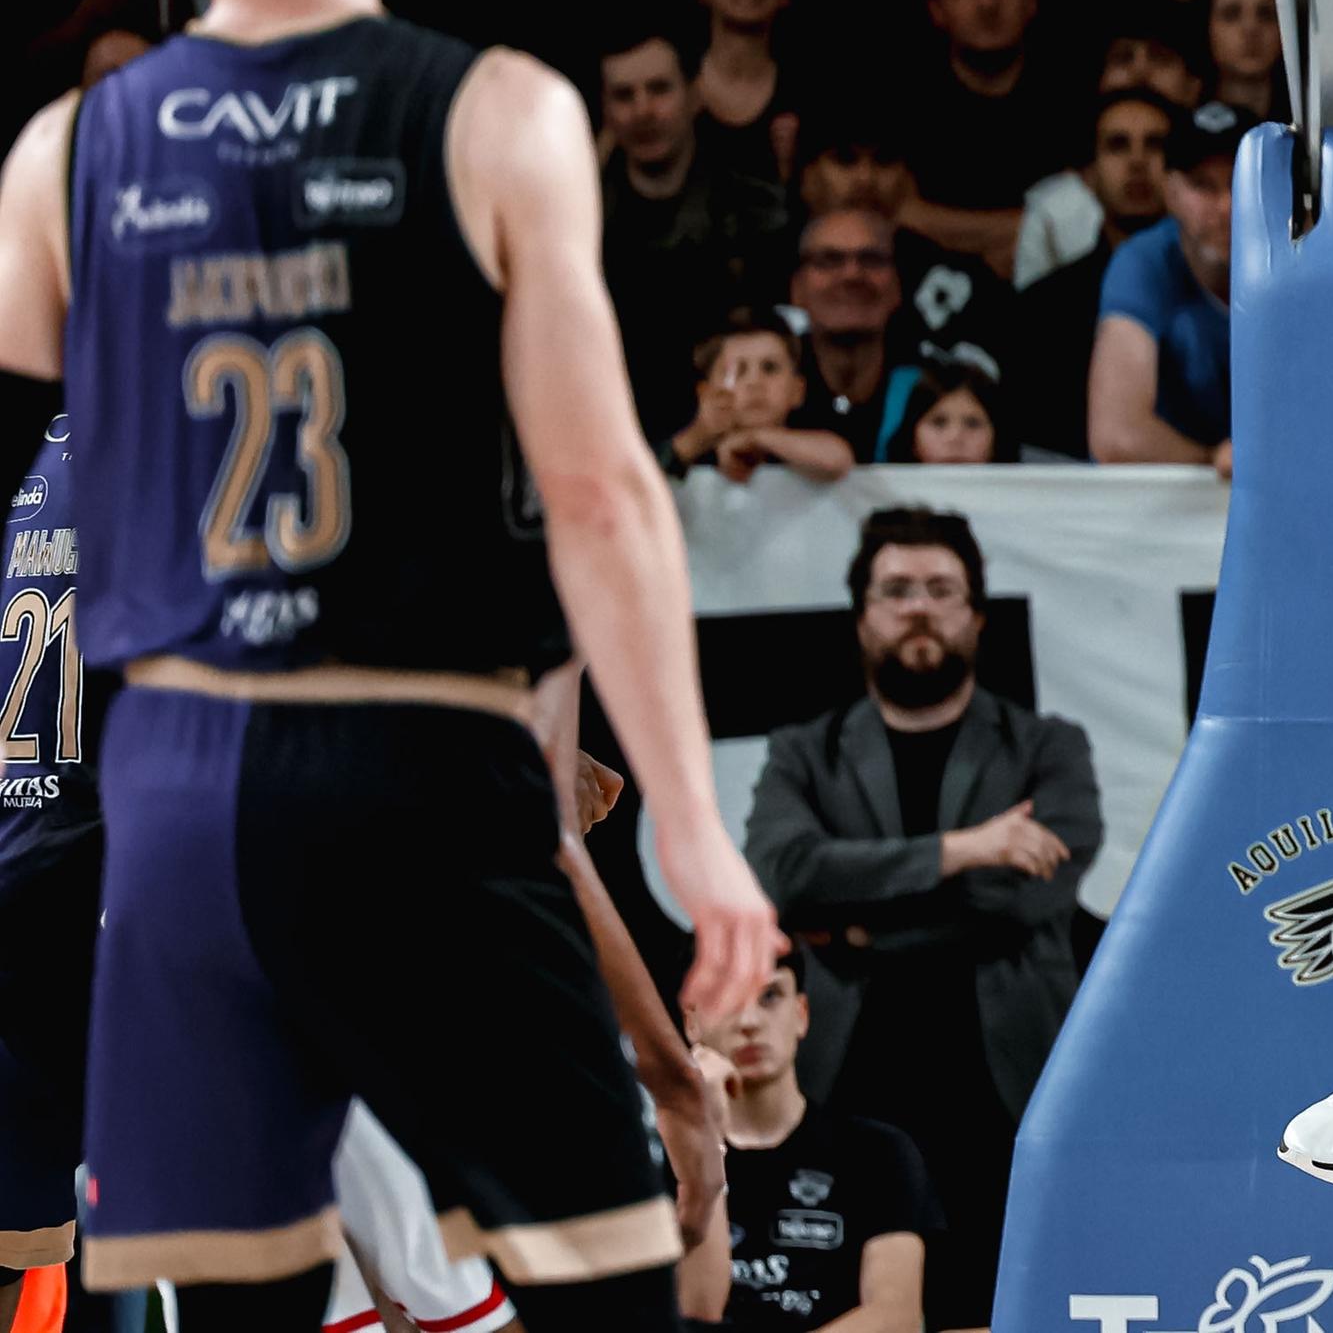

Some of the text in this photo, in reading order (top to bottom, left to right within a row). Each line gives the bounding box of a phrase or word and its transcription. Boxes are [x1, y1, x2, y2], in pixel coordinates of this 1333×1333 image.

[157, 76, 358, 143] CAVIT
[10, 486, 44, 508] elinda
[182, 324, 351, 579] 23
[0, 588, 82, 764] 21
